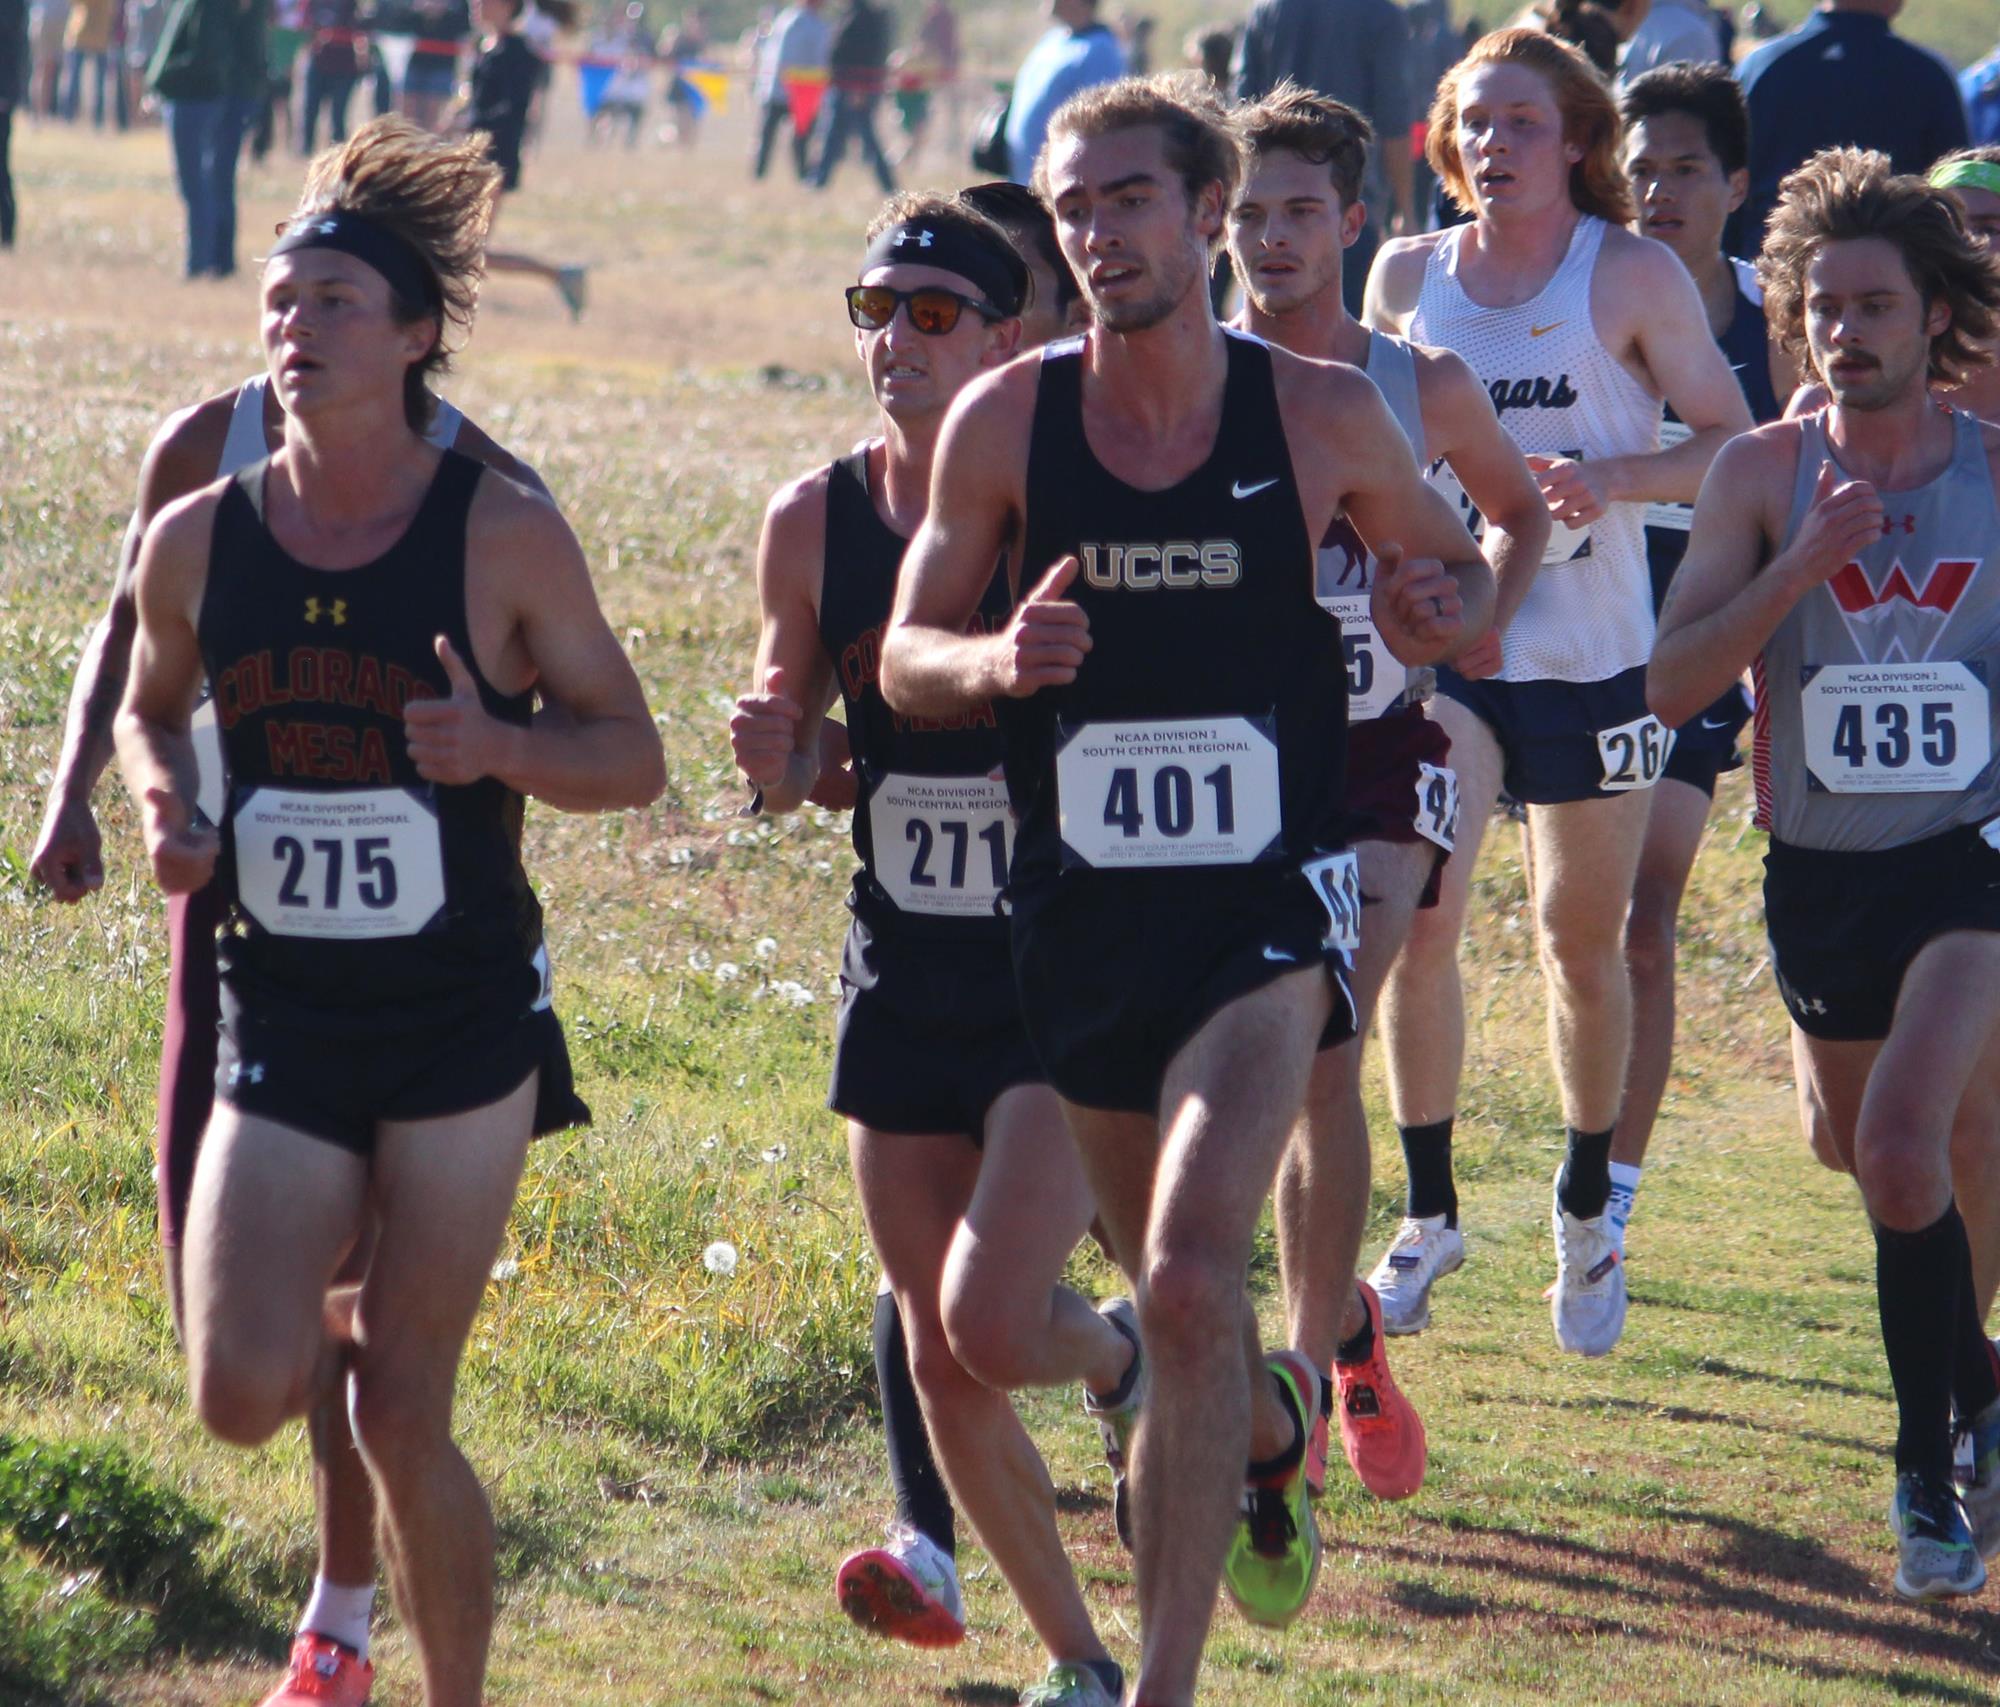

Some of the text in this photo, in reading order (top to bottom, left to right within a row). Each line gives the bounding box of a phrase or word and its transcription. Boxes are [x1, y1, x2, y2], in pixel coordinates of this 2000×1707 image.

[1482, 374, 1578, 418] gars
[1081, 540, 1241, 591] UCCS
[1327, 605, 1351, 613] SION
[1341, 615, 1372, 624] EGION
[1848, 673, 1879, 682] NCAA
[1882, 672, 1929, 682] DIVISION
[1821, 683, 1966, 694] SOUTH CENTRAL REGIONAL
[1115, 733, 1150, 743] NCAA
[1154, 731, 1208, 741] DIVISION
[1833, 702, 1957, 768] 435
[265, 720, 392, 784] MESA
[1082, 742, 1250, 757] SOUTH CENTRAL REGIONAL
[1606, 721, 1670, 784] 26
[907, 787, 935, 797] NCAA
[937, 788, 986, 798] DIVISION
[280, 803, 310, 812] NCAA
[313, 804, 367, 814] DIVISION
[886, 796, 1011, 811] SOUTH CENTRAL REGION
[1103, 764, 1234, 838] 401
[255, 813, 411, 827] SOUTH CENTRAL REGIONAL
[905, 818, 1009, 889] 271
[272, 836, 398, 910] 275
